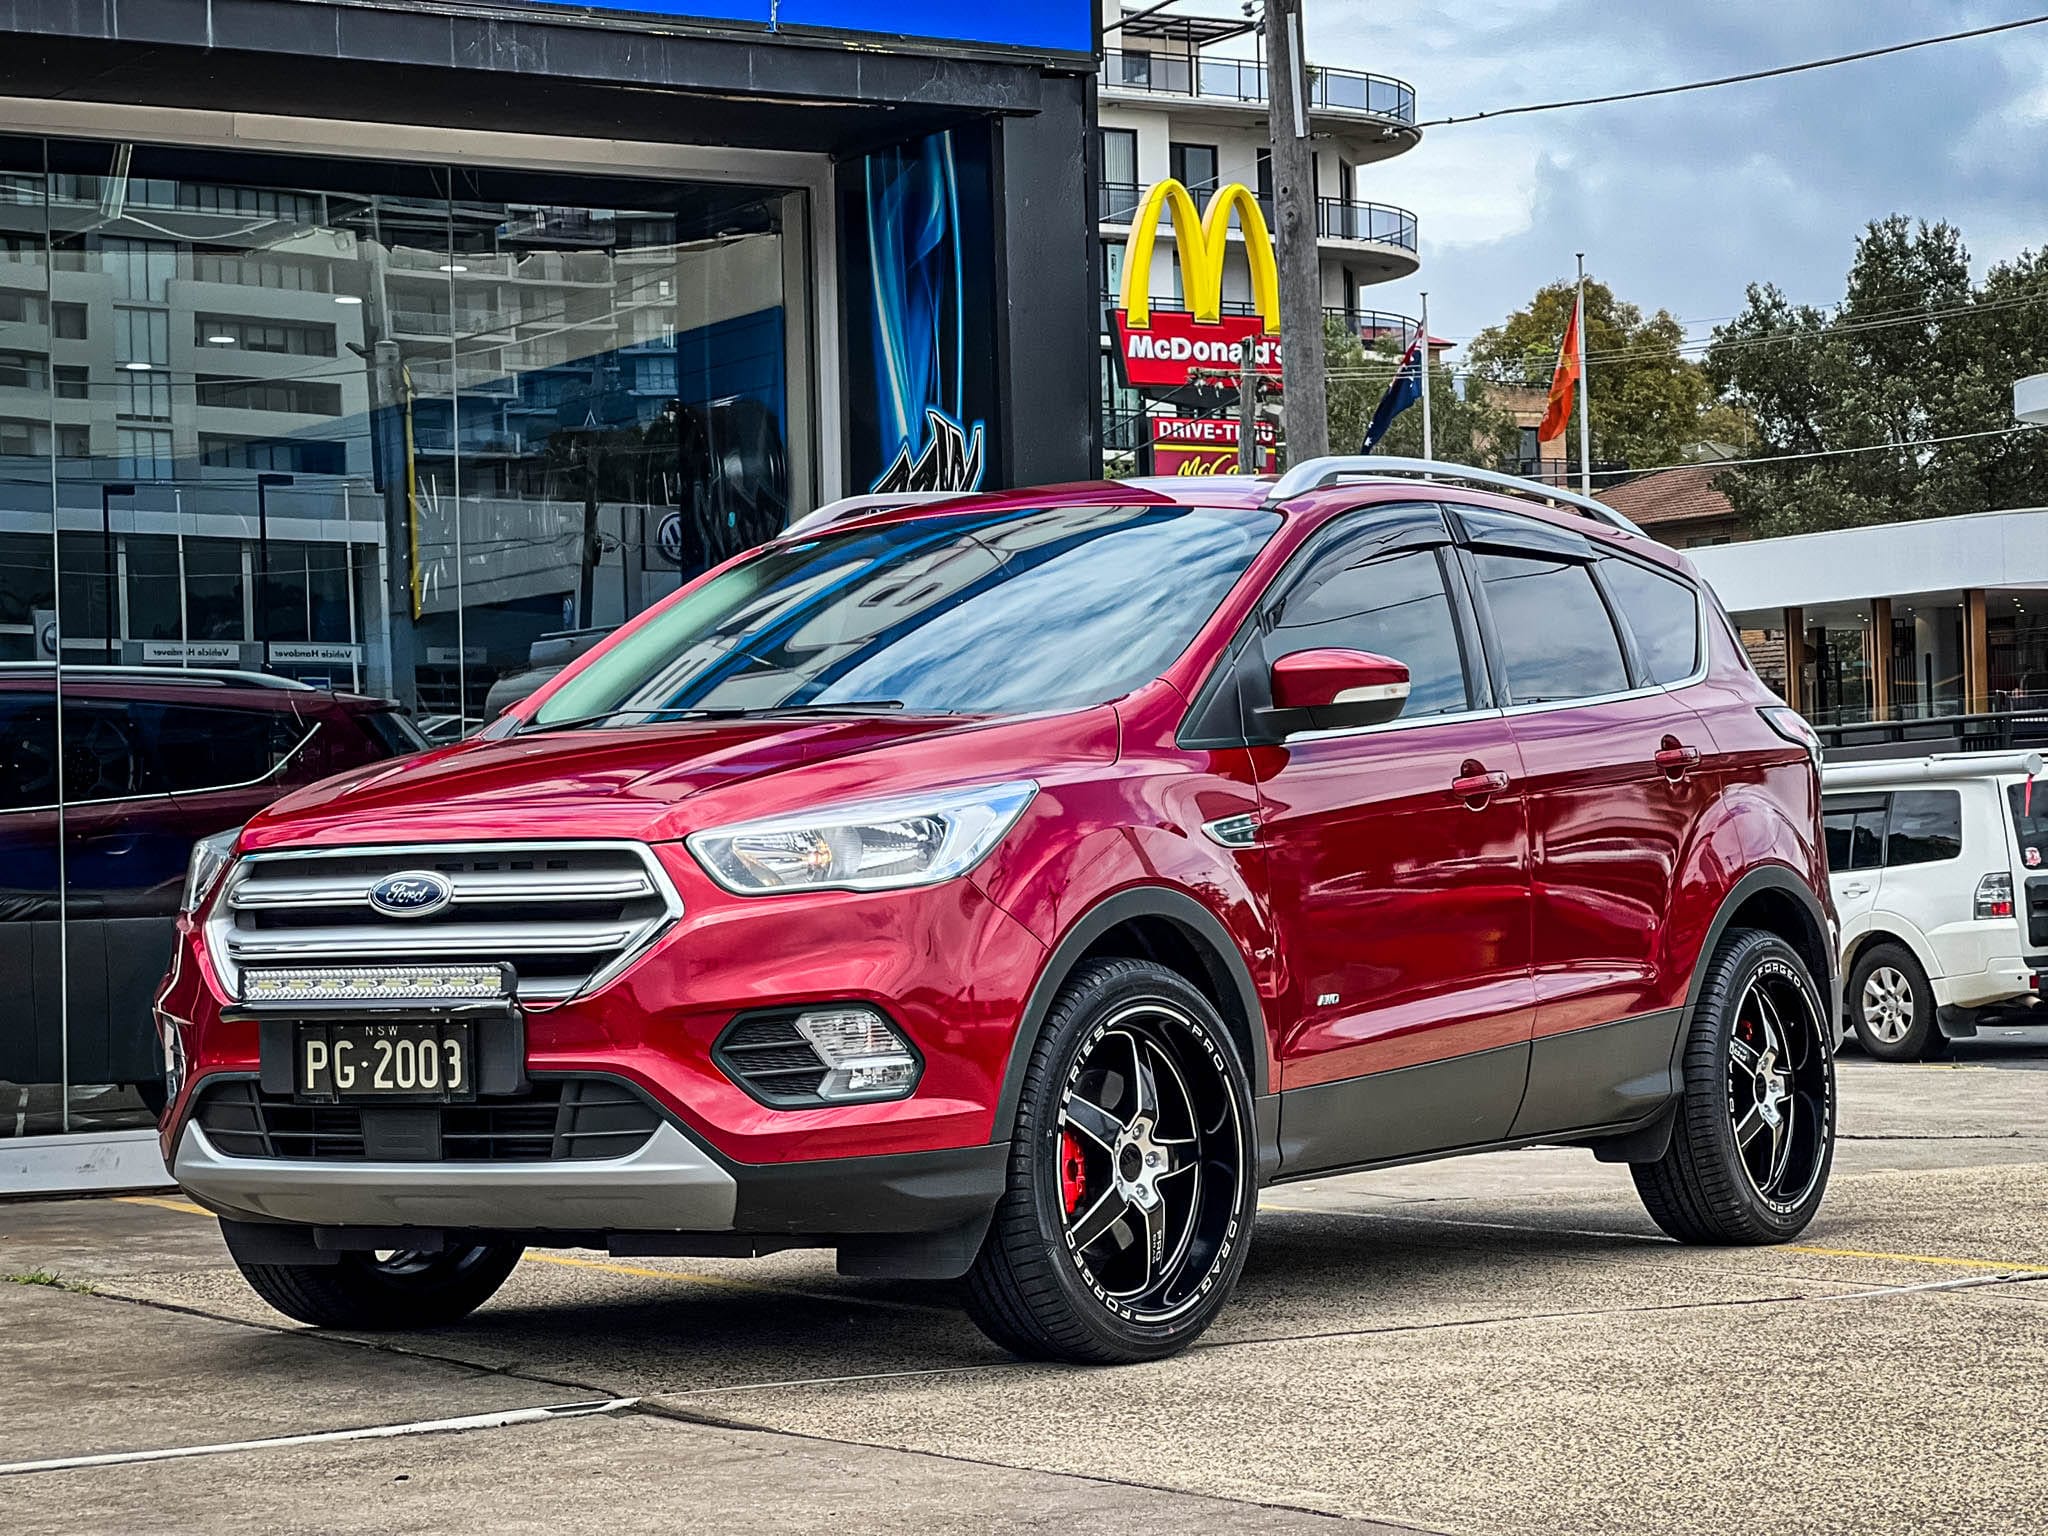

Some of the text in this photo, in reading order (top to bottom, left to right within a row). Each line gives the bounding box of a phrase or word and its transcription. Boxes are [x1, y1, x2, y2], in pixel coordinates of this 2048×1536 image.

[1177, 453, 1260, 477] McCa
[385, 881, 430, 903] Ford
[1757, 962, 1801, 988] FORGED
[365, 1025, 399, 1036] NSW
[1191, 1024, 1225, 1072] PRO
[1057, 1025, 1105, 1126] SERIES
[1066, 1230, 1134, 1320] FORGED
[1202, 1220, 1238, 1294] DRAG
